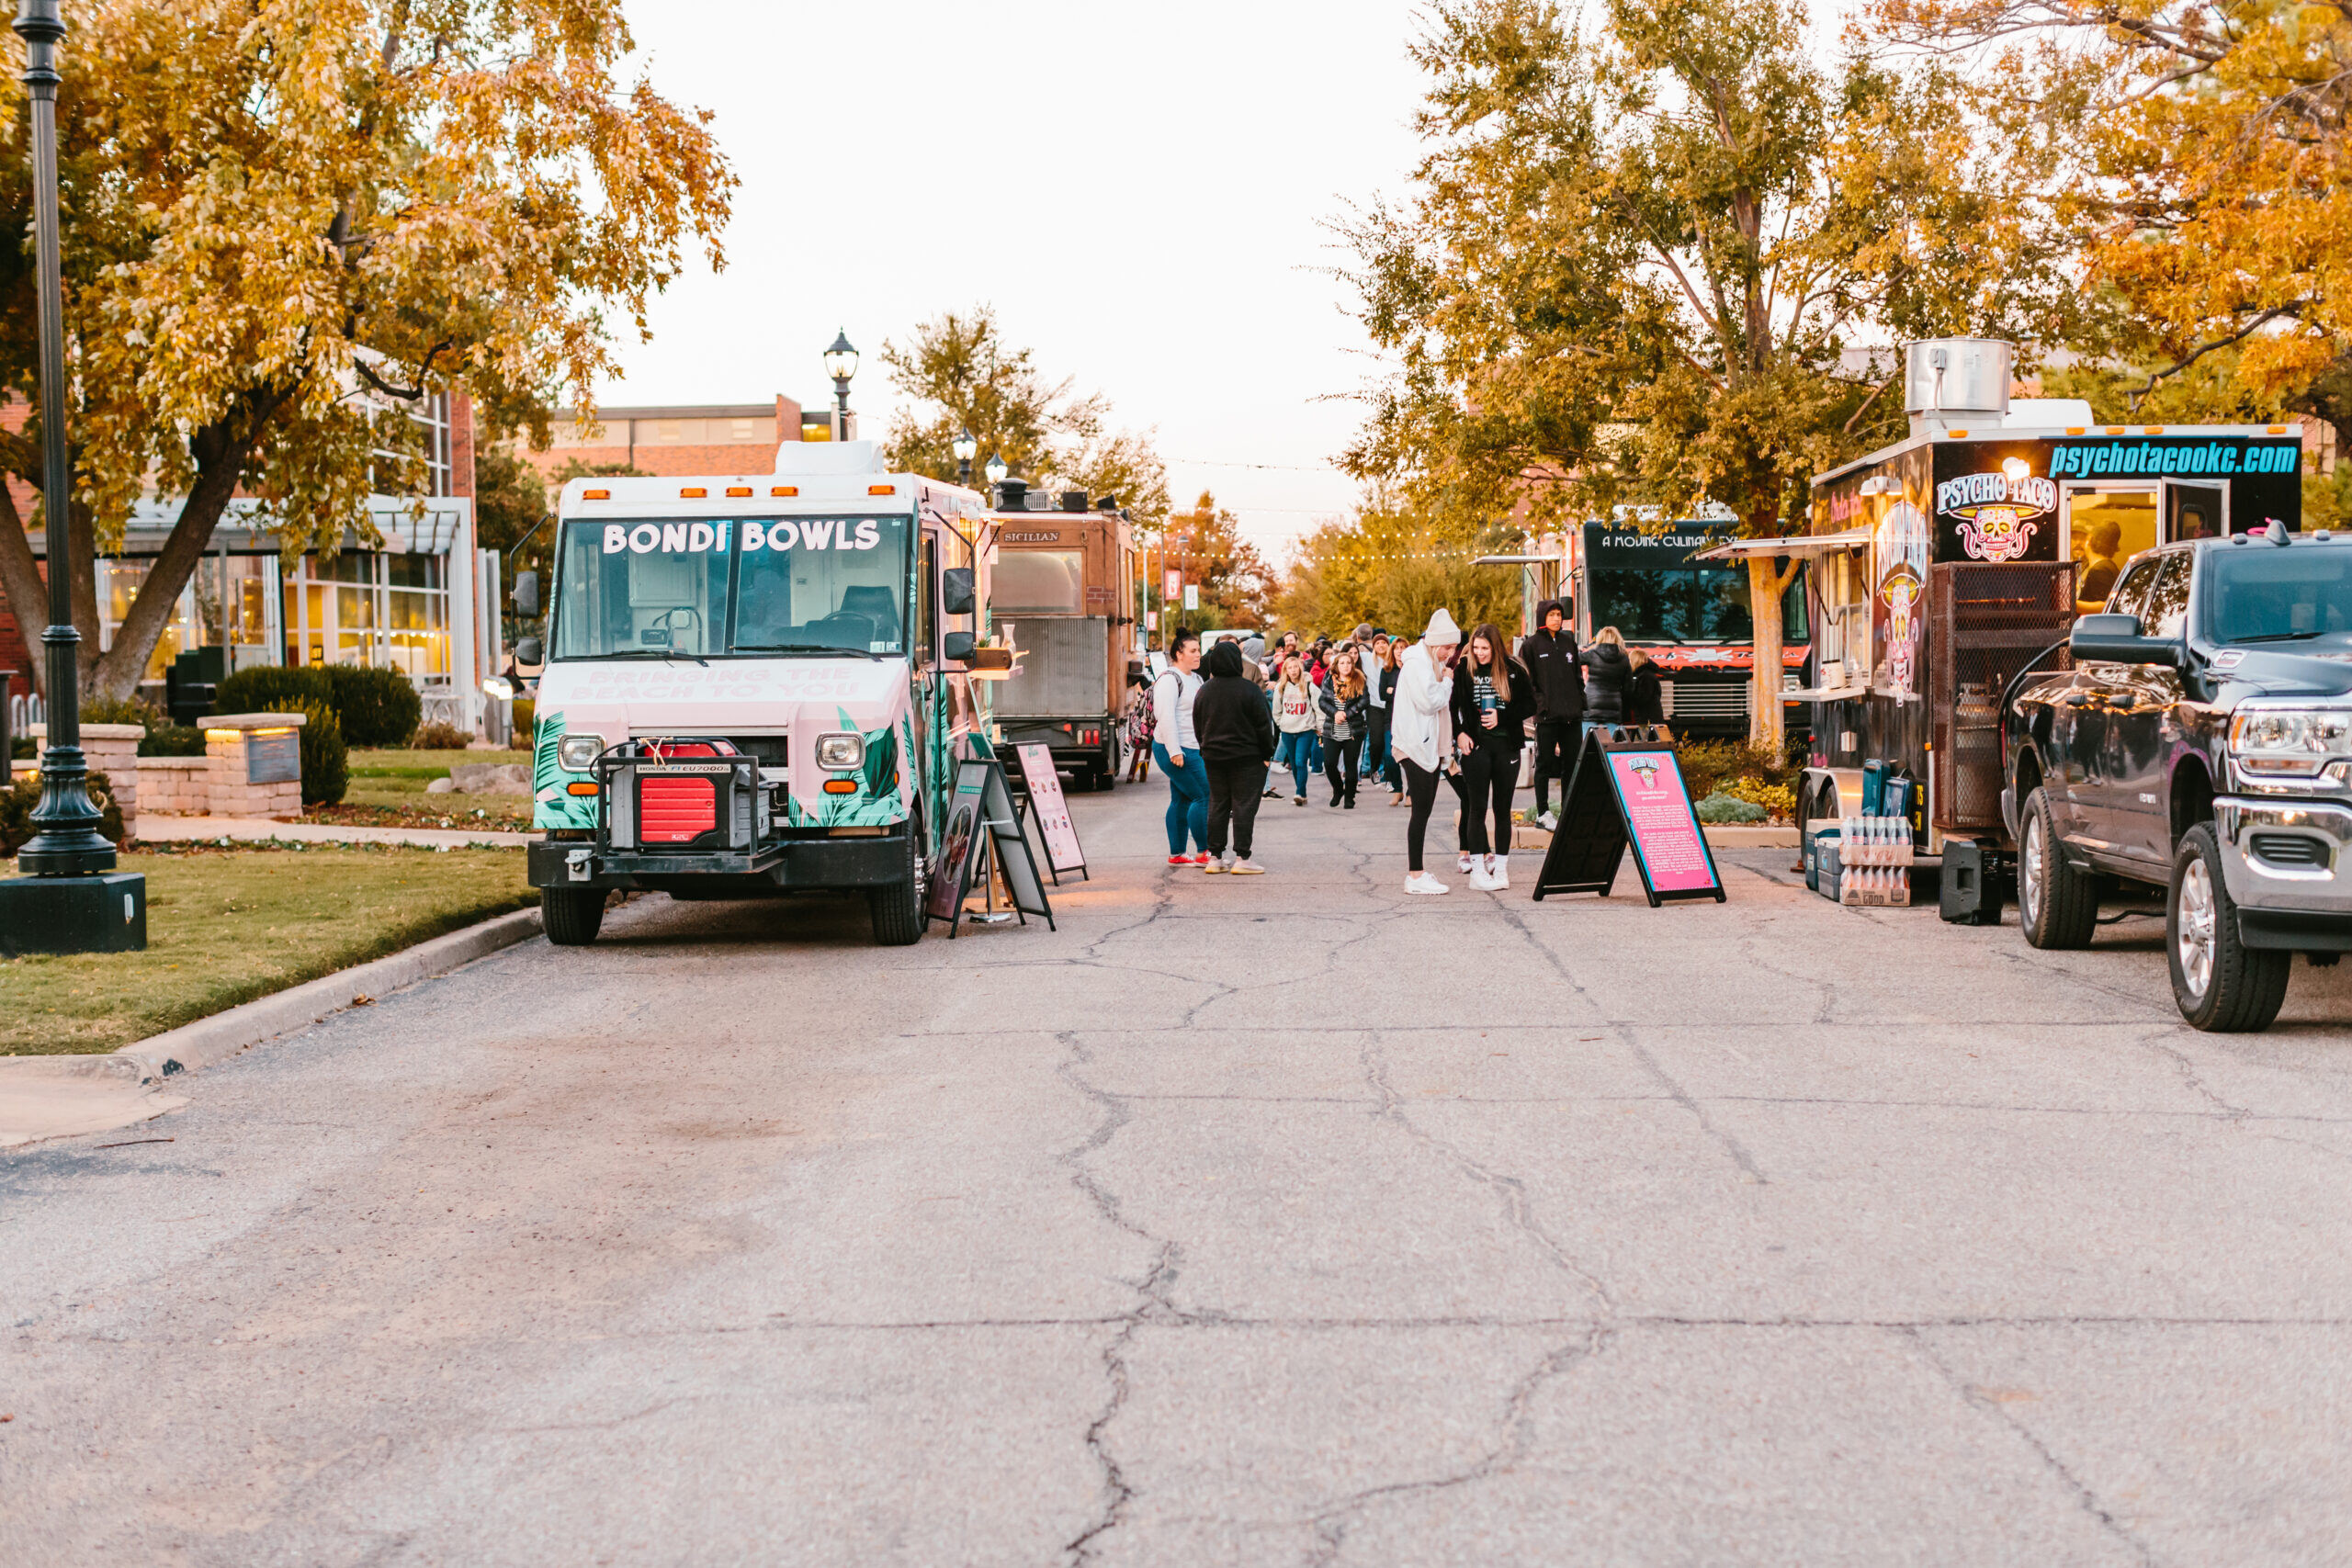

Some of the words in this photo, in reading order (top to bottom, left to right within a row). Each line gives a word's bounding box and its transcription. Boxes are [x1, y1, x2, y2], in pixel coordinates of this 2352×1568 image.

[2049, 442, 2297, 479] psychotacookc.com
[1938, 474, 2007, 513] PSYCHO
[2012, 476, 2057, 511] TACO
[603, 524, 727, 554] BONDI
[741, 519, 880, 552] BOWLS
[1004, 532, 1059, 542] SICILIAN
[1602, 536, 1611, 547] A
[1614, 536, 1658, 547] MOVING
[589, 669, 771, 684] BRINGING
[787, 667, 854, 681] THE
[571, 685, 695, 700] BEACH
[709, 683, 763, 697] TO
[779, 682, 861, 696] YOU
